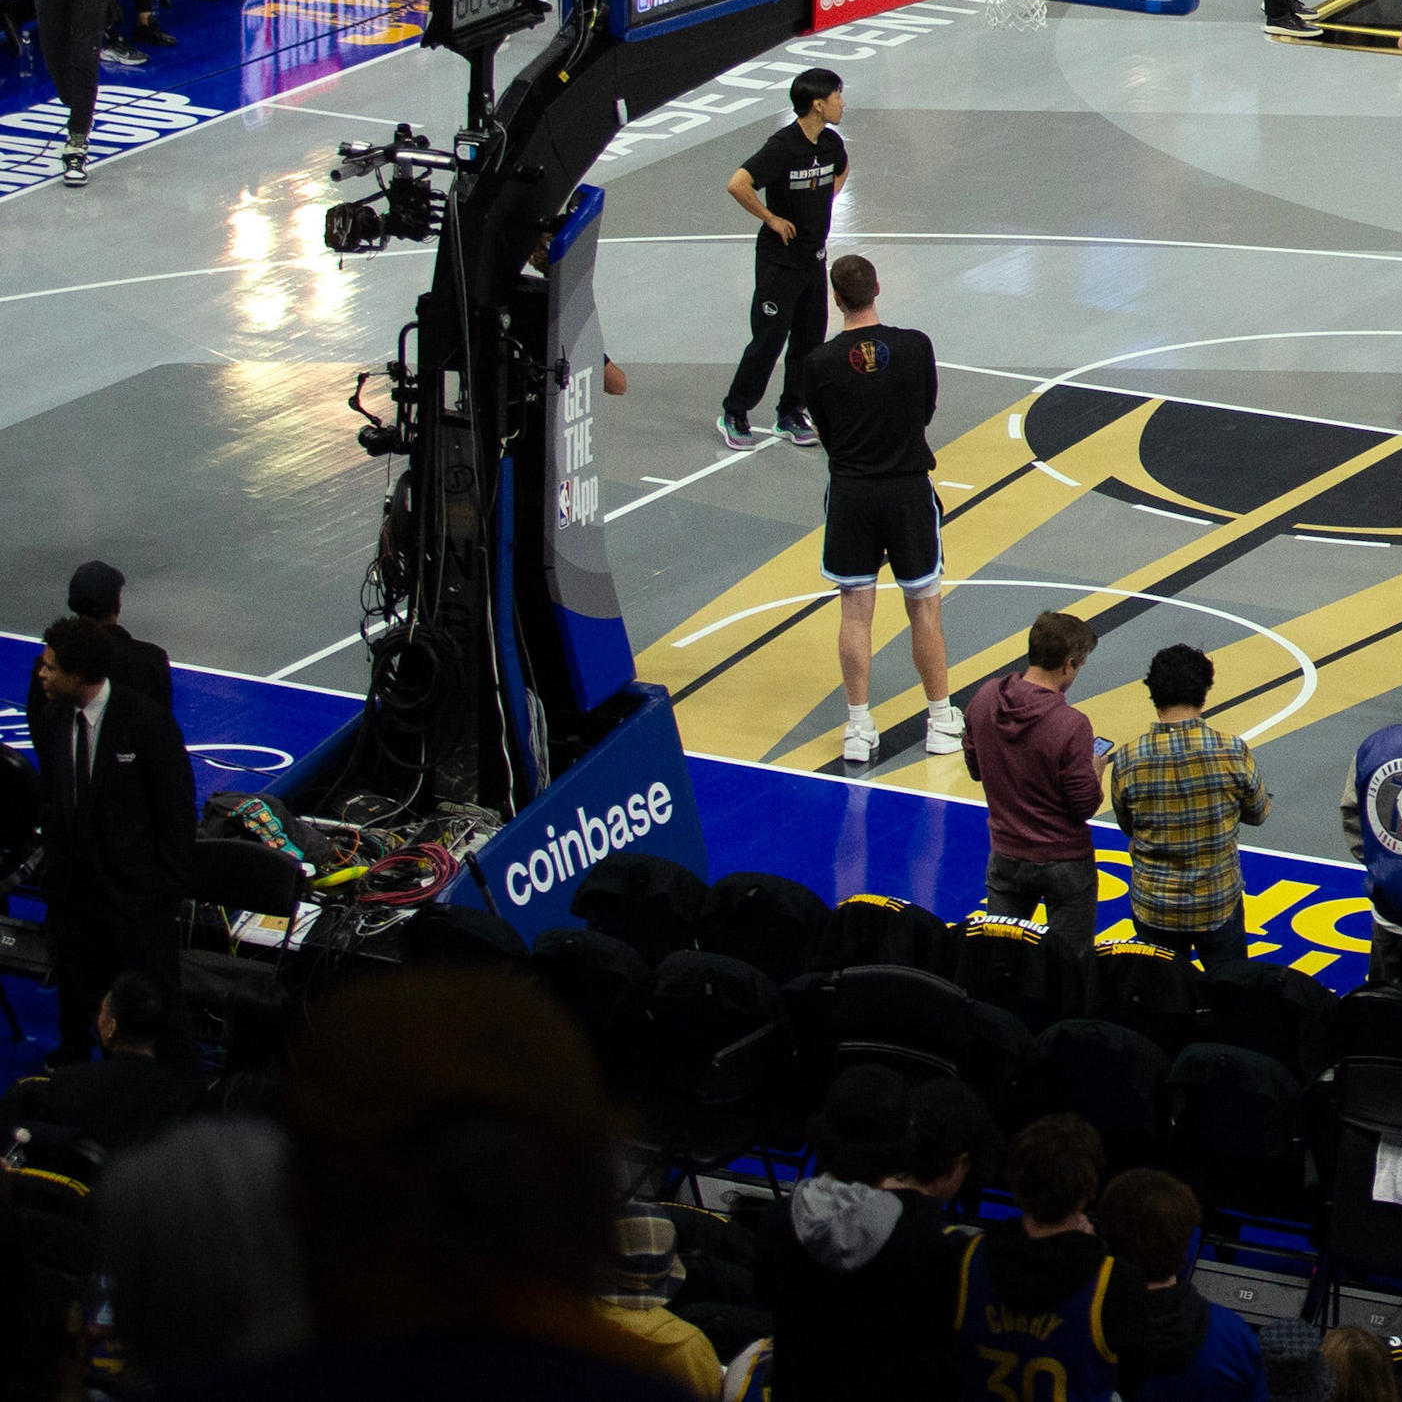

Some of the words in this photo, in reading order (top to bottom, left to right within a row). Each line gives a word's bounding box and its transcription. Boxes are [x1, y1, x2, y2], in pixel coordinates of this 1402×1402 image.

[564, 365, 594, 424] GET
[564, 416, 594, 474] THE
[571, 476, 599, 528] App
[506, 781, 673, 907] coinbase
[1238, 1288, 1255, 1301] 113
[1369, 1314, 1385, 1326] 112
[984, 1304, 1063, 1342] CURRY
[977, 1345, 1067, 1402] 30
